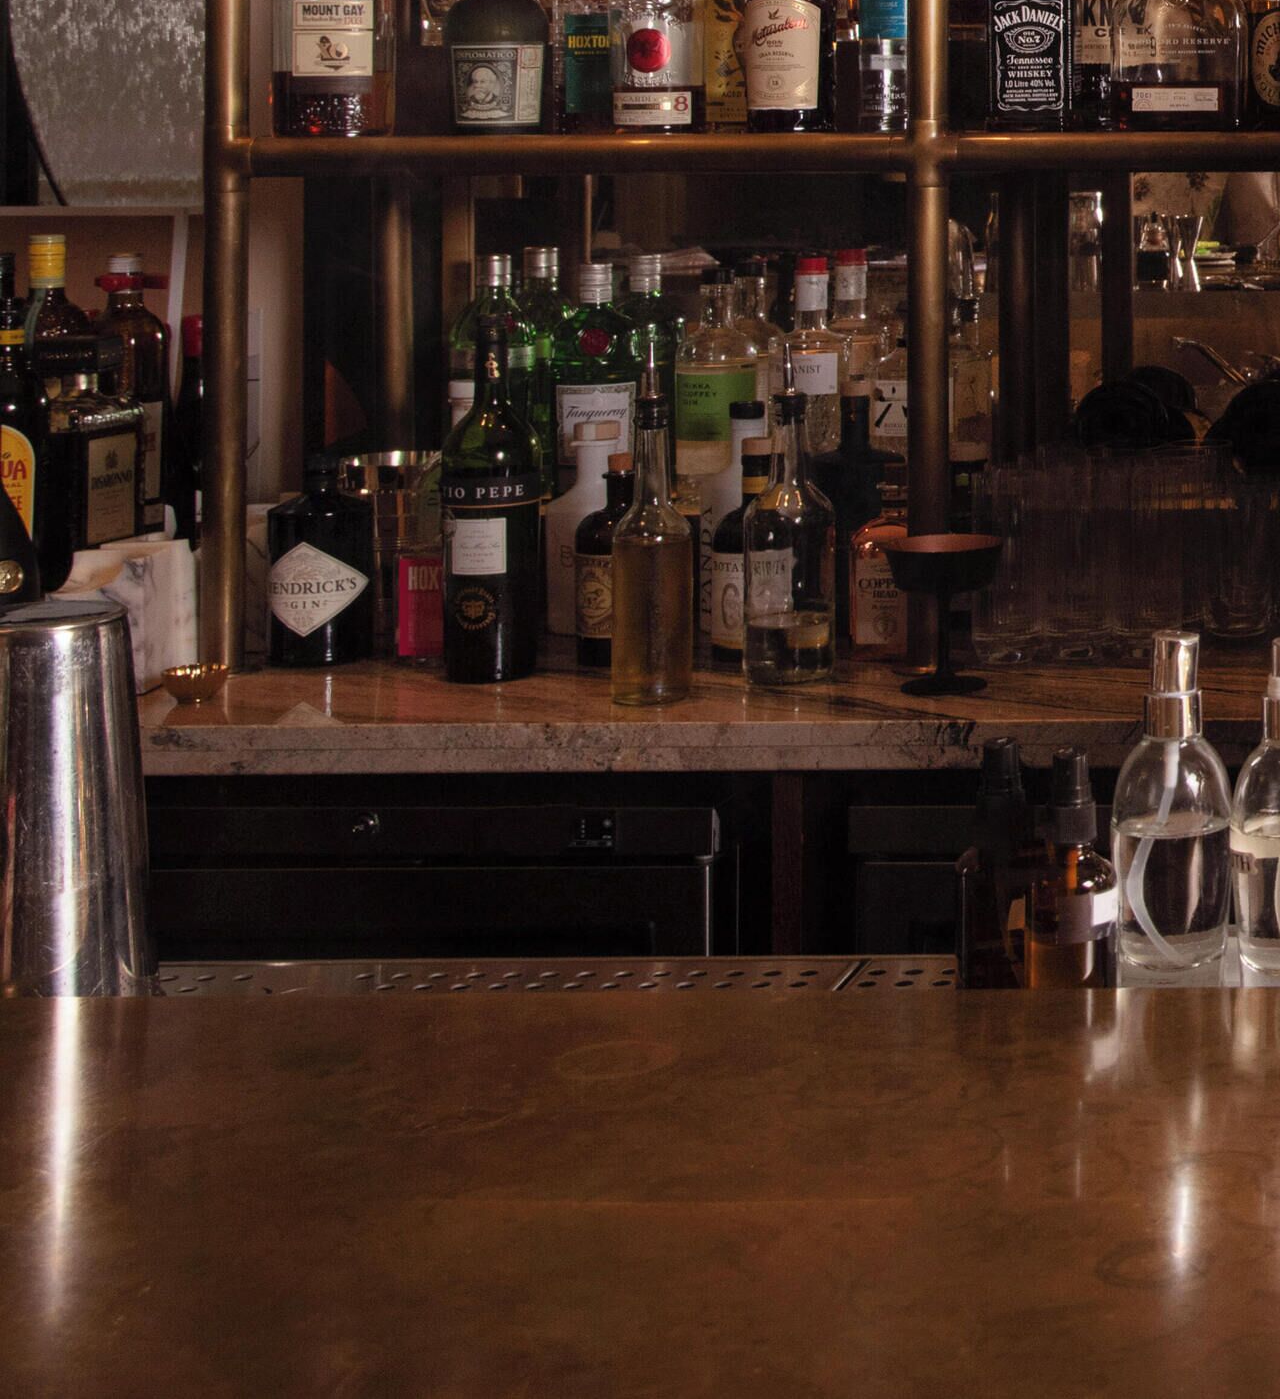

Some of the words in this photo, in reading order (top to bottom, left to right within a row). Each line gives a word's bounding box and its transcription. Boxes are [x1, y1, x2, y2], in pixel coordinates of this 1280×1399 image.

[302, 4, 339, 15] MOUNT
[343, 4, 364, 14] GAY
[993, 10, 1021, 33] JACK
[1021, 5, 1066, 32] DANIEL'S
[752, 17, 808, 46] Matusalem
[1018, 35, 1041, 44] No.7
[1182, 37, 1230, 45] RESERVE
[1006, 54, 1053, 65] Tennessee
[1007, 70, 1053, 78] WHISKEY
[1014, 79, 1029, 87] Litre
[1030, 79, 1043, 87] 40%
[1044, 79, 1056, 87] Vol.
[674, 95, 688, 112] 8
[564, 405, 628, 422] Tanqueray
[475, 484, 525, 499] PEPE
[290, 601, 321, 610] GIN
